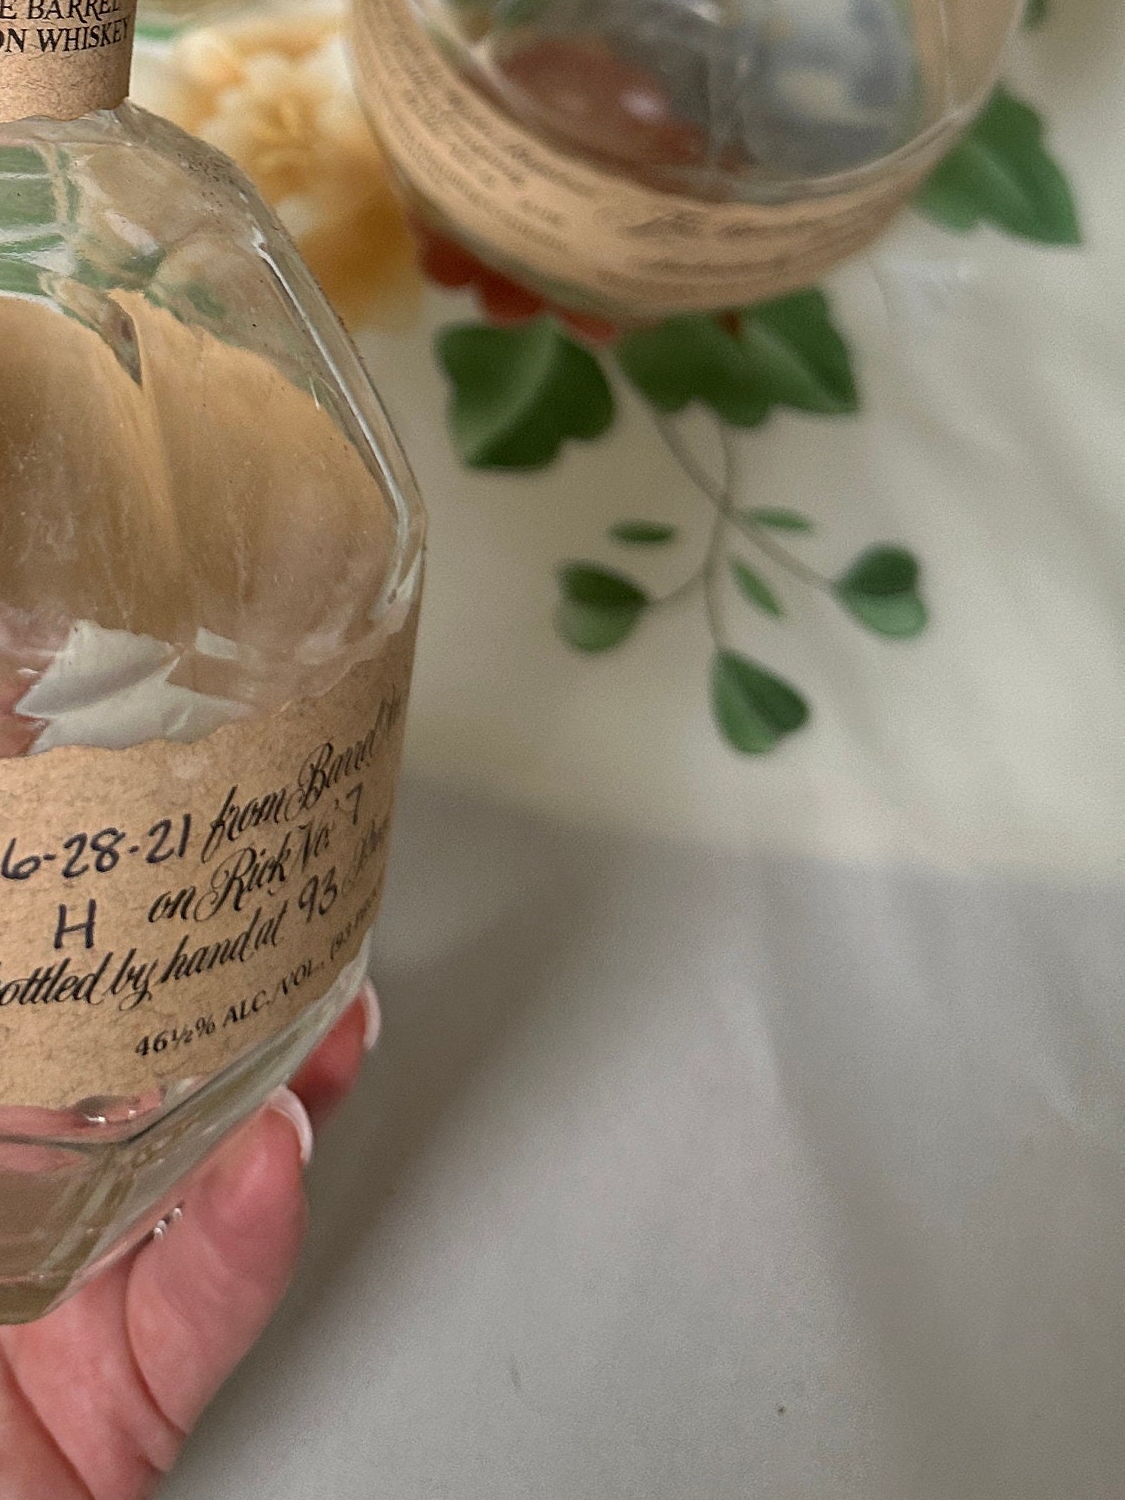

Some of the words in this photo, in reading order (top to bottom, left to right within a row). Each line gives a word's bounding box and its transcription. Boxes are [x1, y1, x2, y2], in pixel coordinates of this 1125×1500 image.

[36, 16, 131, 53] WHISKEY
[1, 813, 192, 880] 6-28-21
[201, 784, 286, 864] from
[54, 899, 97, 949] H
[147, 885, 196, 923] on
[194, 832, 292, 921] Rick
[102, 948, 159, 1012] by
[156, 906, 263, 985] hand
[253, 899, 288, 950] at
